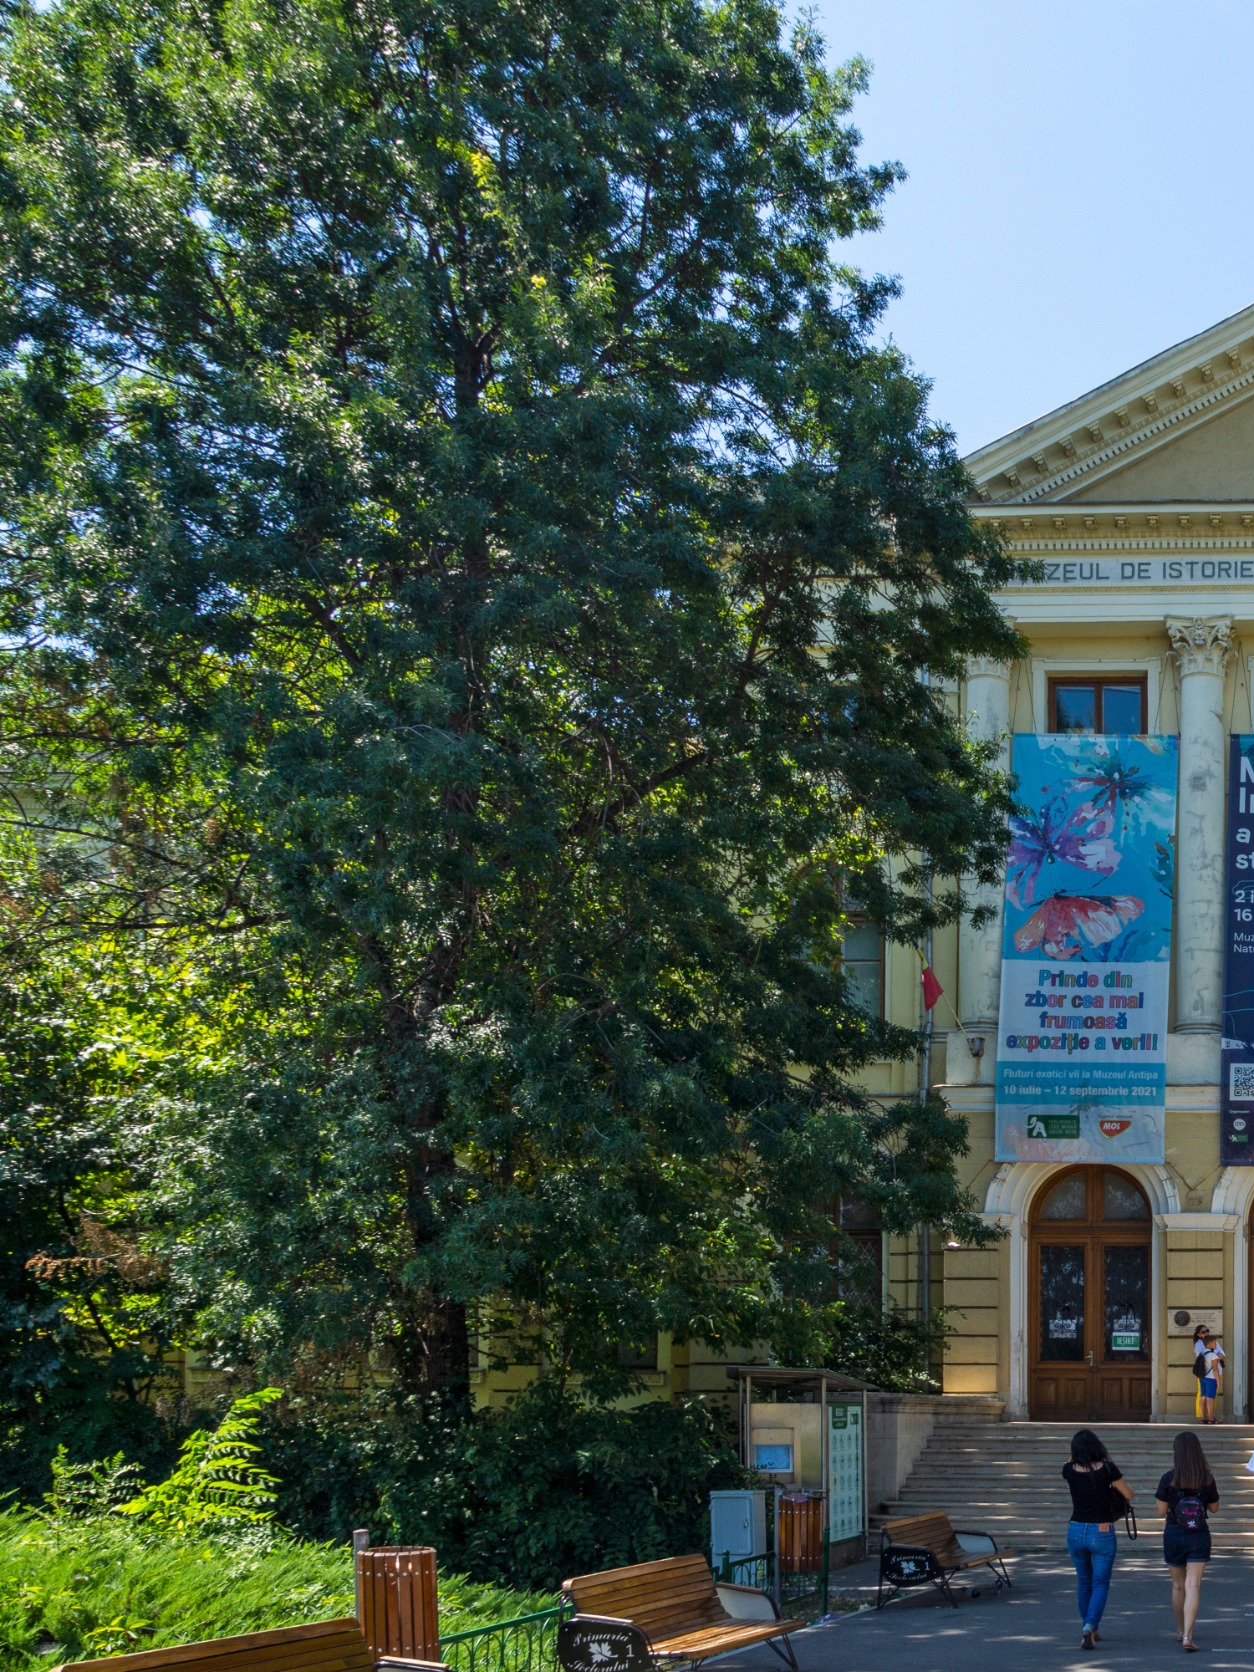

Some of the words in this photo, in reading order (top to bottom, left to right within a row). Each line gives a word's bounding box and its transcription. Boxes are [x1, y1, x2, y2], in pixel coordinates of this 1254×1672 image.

[1046, 562, 1110, 580] ZEUL
[1121, 562, 1152, 580] DE
[1162, 561, 1254, 579] ISTORIE
[1235, 827, 1251, 844] a
[1234, 890, 1246, 903] 2
[1234, 908, 1253, 922] 16
[1039, 969, 1099, 988] Prinde
[1103, 970, 1133, 988] din
[1024, 990, 1067, 1008] zbor
[1071, 994, 1104, 1009] cea
[1109, 991, 1144, 1009] mai
[1039, 1011, 1127, 1030] frumoasă
[1094, 1036, 1106, 1050] a
[1112, 1033, 1158, 1050] verii!
[1003, 1069, 1034, 1078] Fluturi
[1035, 1069, 1066, 1079] exotici
[1068, 1069, 1080, 1079] vii
[1082, 1069, 1091, 1079] la
[1092, 1069, 1126, 1079] Muzeul
[1128, 1070, 1158, 1081] Antipa
[1003, 1085, 1017, 1095] 10
[1019, 1085, 1042, 1095] iulie
[1054, 1085, 1067, 1095] 12
[1069, 1085, 1129, 1097] septembrie
[1131, 1086, 1156, 1096] 2021
[1103, 1122, 1121, 1130] MOL
[625, 1644, 635, 1658] 1
